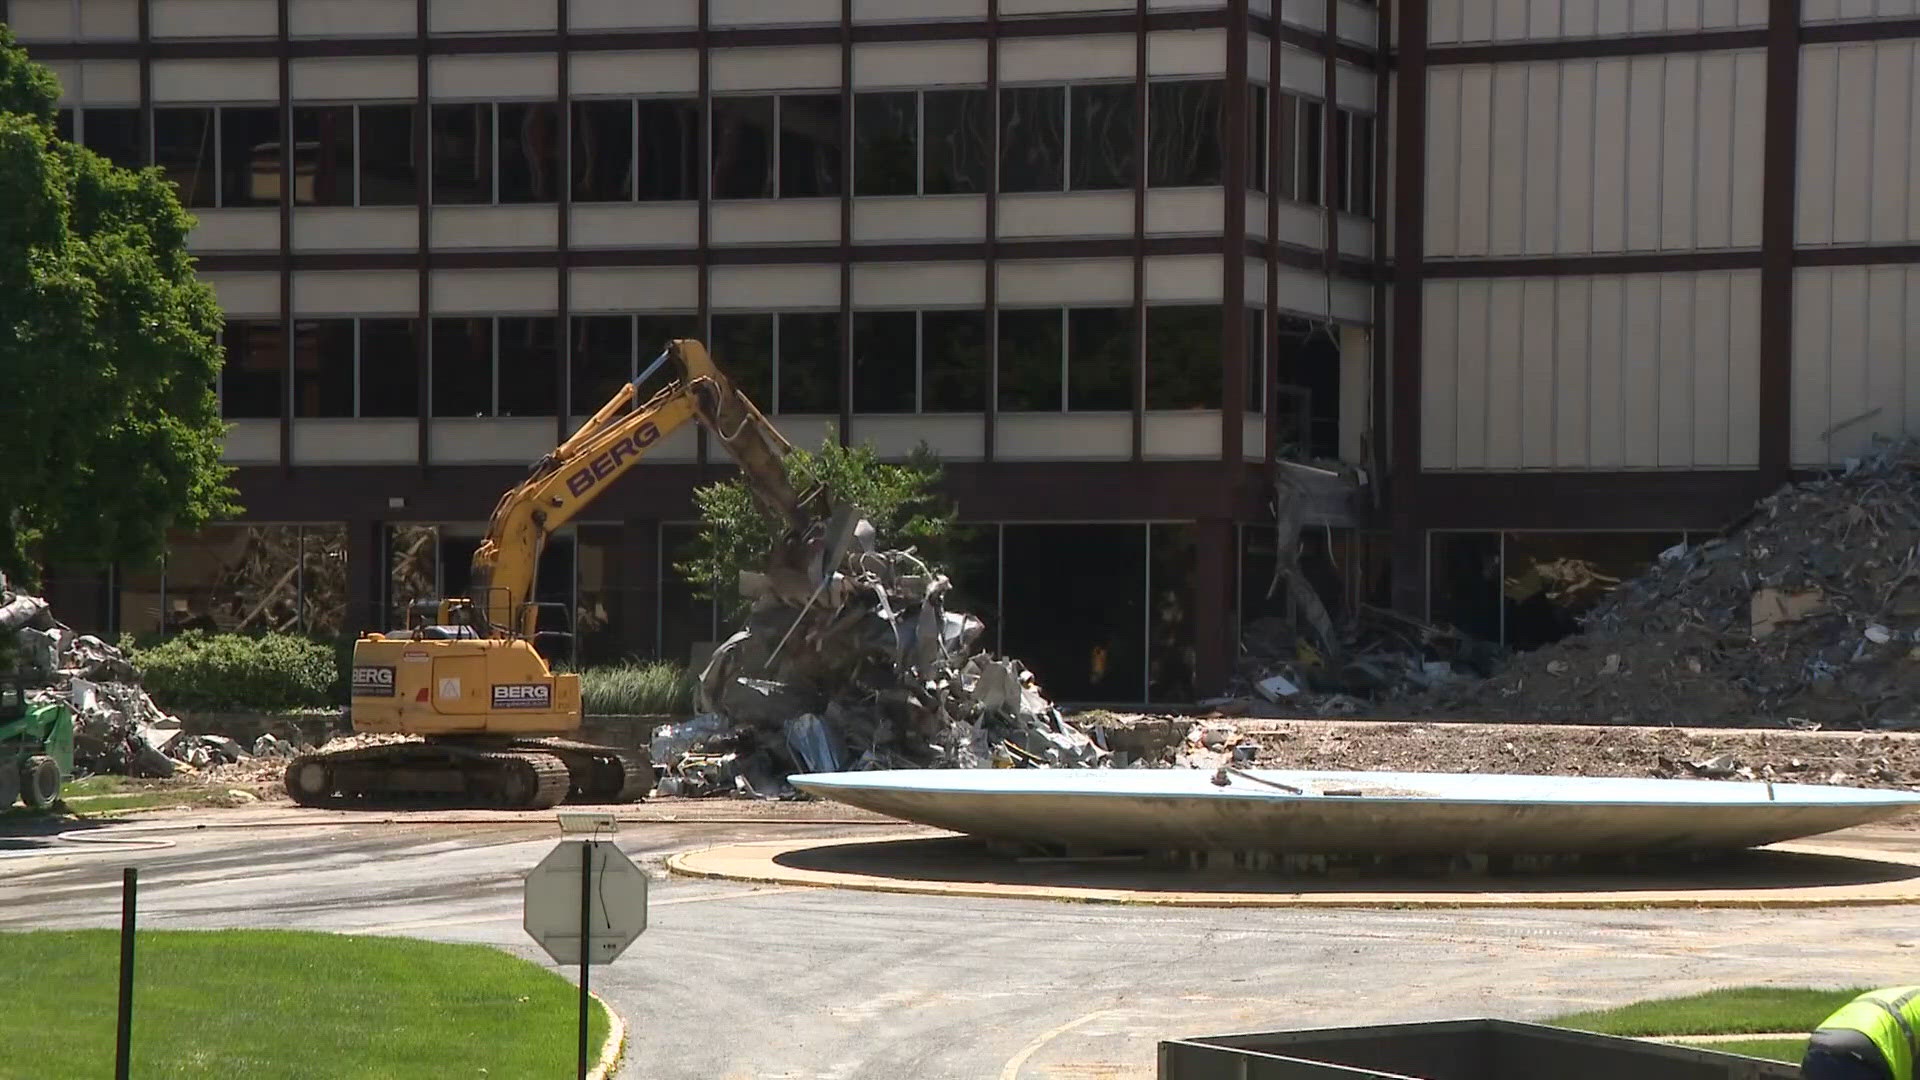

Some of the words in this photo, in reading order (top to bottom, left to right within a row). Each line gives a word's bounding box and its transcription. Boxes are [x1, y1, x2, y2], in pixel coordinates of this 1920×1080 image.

[566, 422, 660, 497] BERG
[352, 668, 392, 683] BERG
[494, 686, 548, 698] BERG
